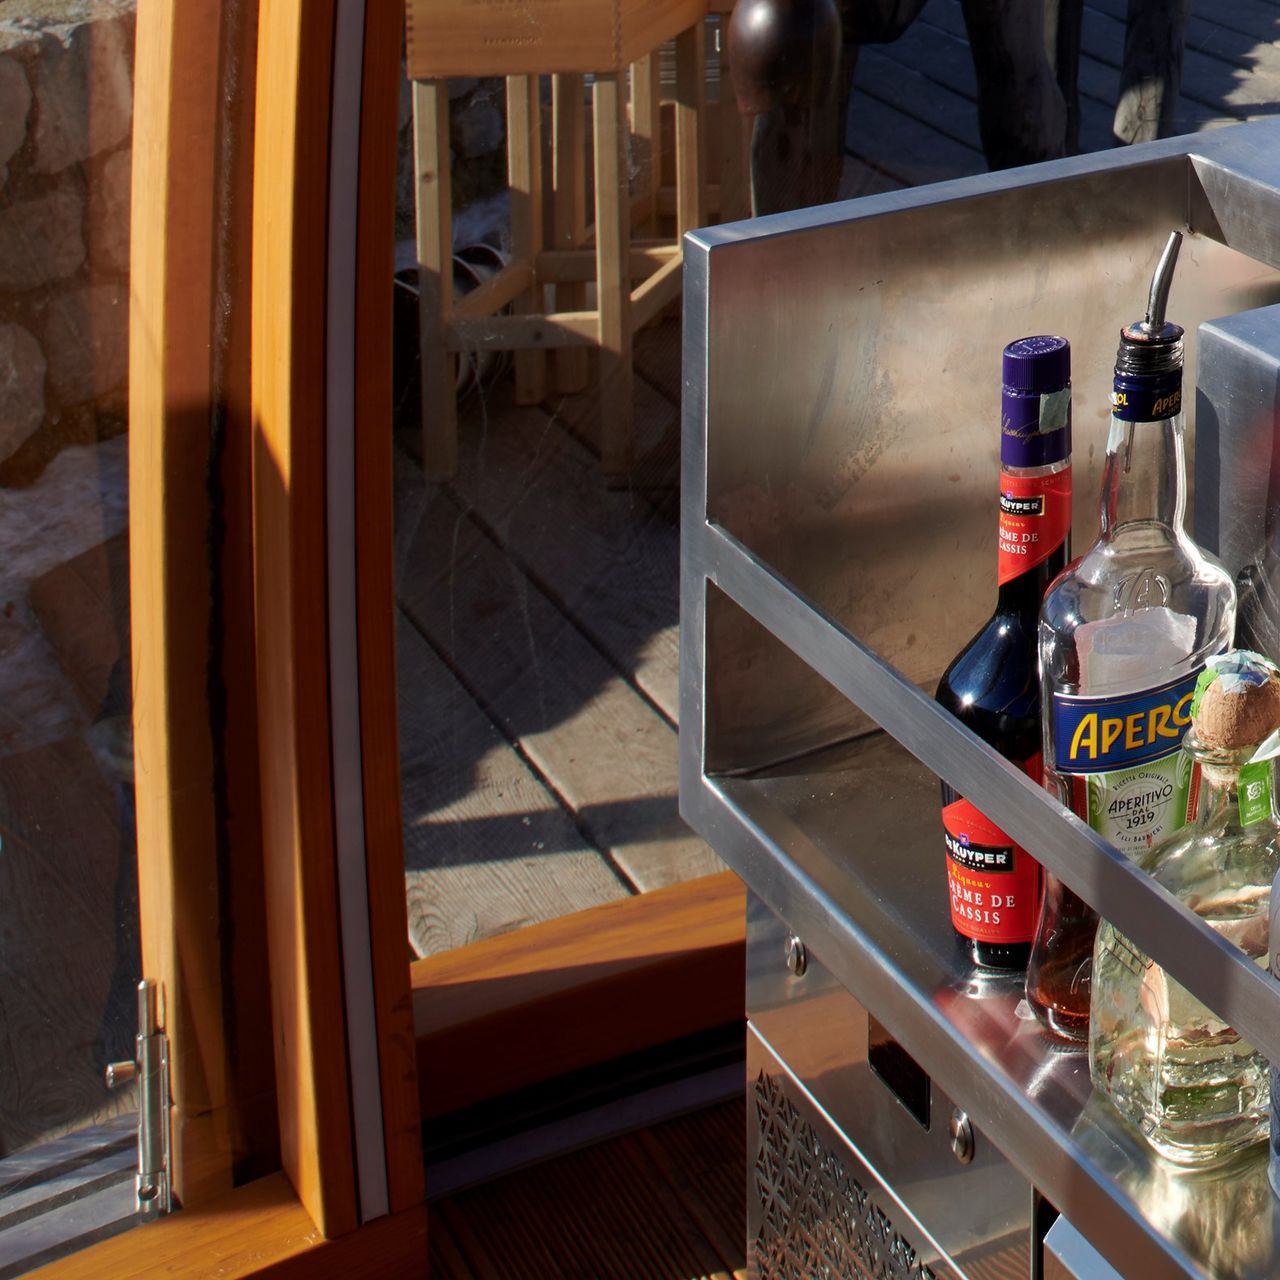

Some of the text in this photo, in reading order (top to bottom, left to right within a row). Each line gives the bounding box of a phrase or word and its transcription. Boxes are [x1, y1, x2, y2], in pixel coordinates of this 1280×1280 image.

[1152, 391, 1181, 416] APER
[1021, 532, 1039, 543] DE
[1069, 692, 1194, 760] APERO
[1112, 772, 1169, 791] RICETTA ORIGINALE
[1108, 784, 1173, 815] APERITIVO
[1126, 812, 1155, 830] 1919
[1132, 807, 1150, 817] DAL
[952, 840, 1006, 864] KUYPER
[951, 863, 991, 889] Liqueur
[952, 896, 1001, 925] CASSIS
[991, 895, 1016, 908] DE
